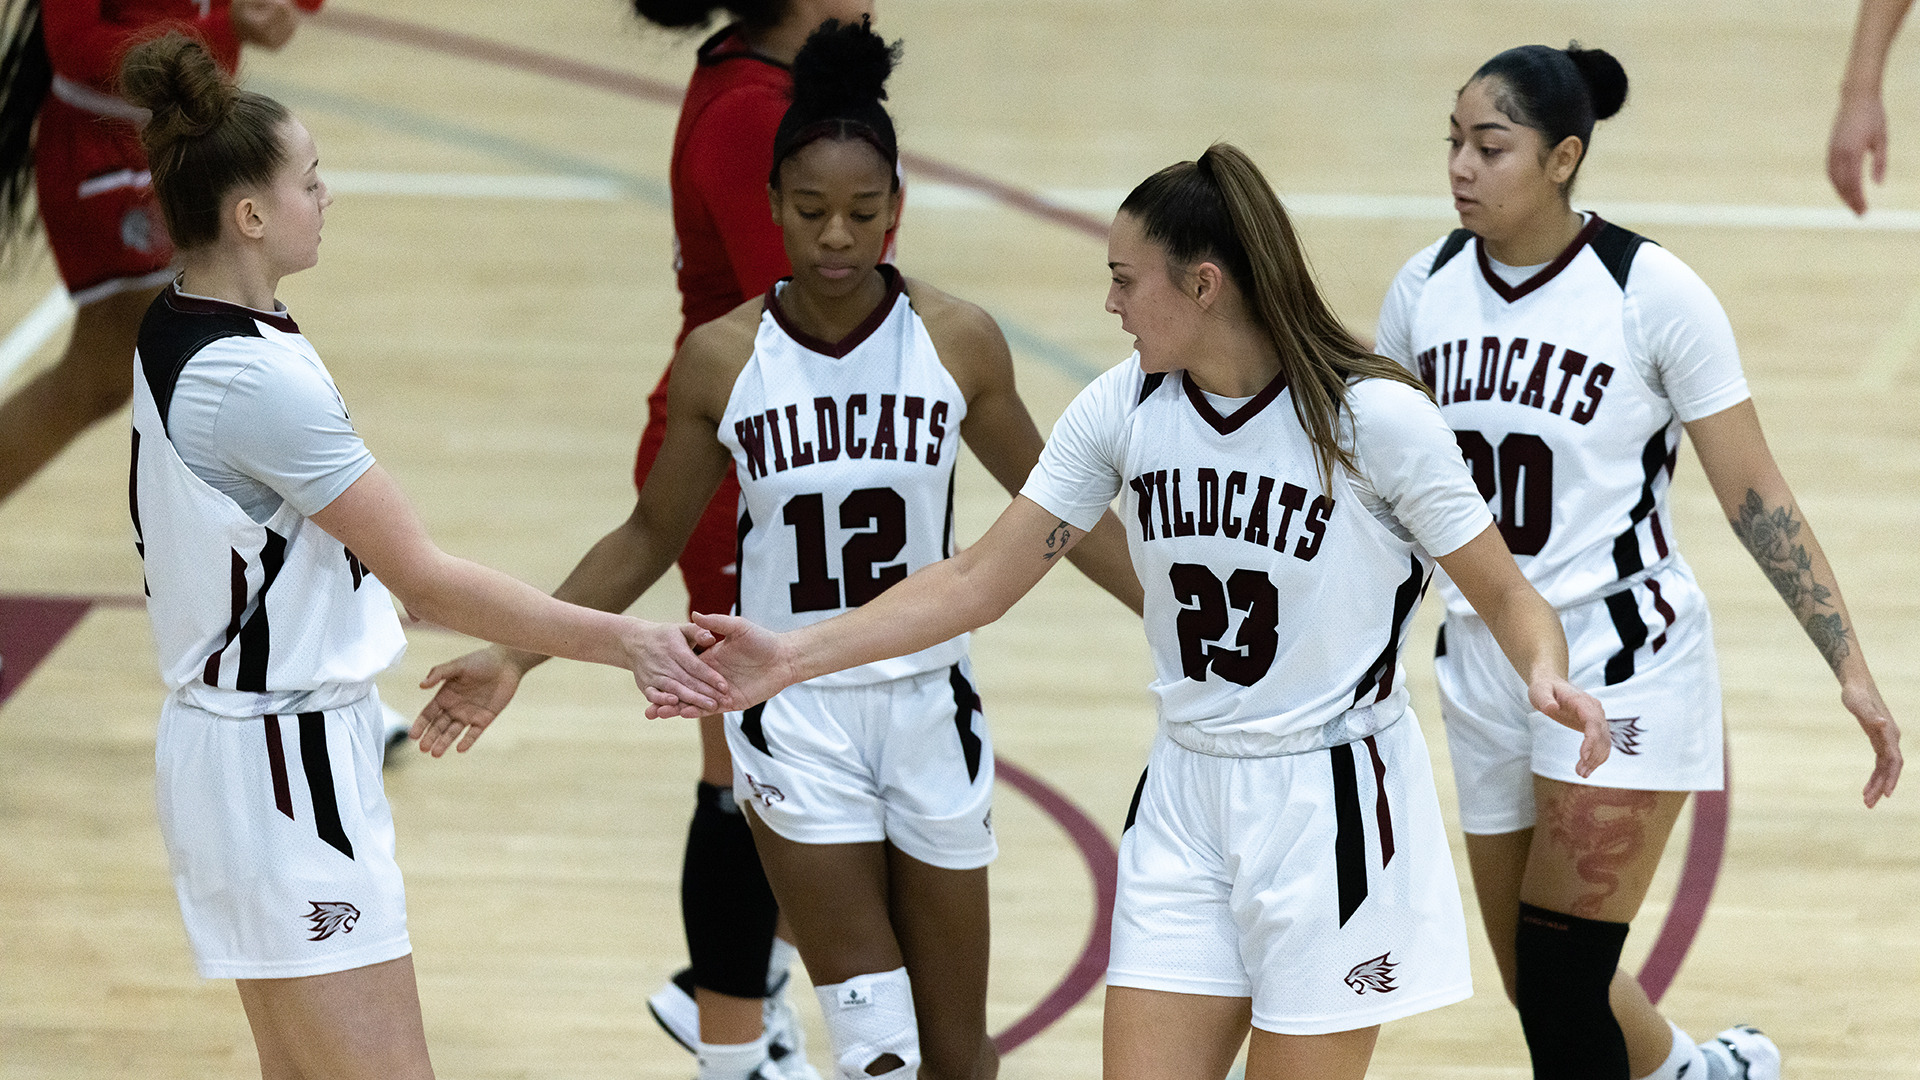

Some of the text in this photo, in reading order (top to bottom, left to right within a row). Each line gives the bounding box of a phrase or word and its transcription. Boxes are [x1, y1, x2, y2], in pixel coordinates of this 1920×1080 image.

[1417, 336, 1615, 425] WILDCATS
[734, 393, 949, 481] WILDCATS
[783, 487, 908, 613] 12
[1129, 467, 1336, 562] WILDCATS
[1169, 562, 1279, 688] 23
